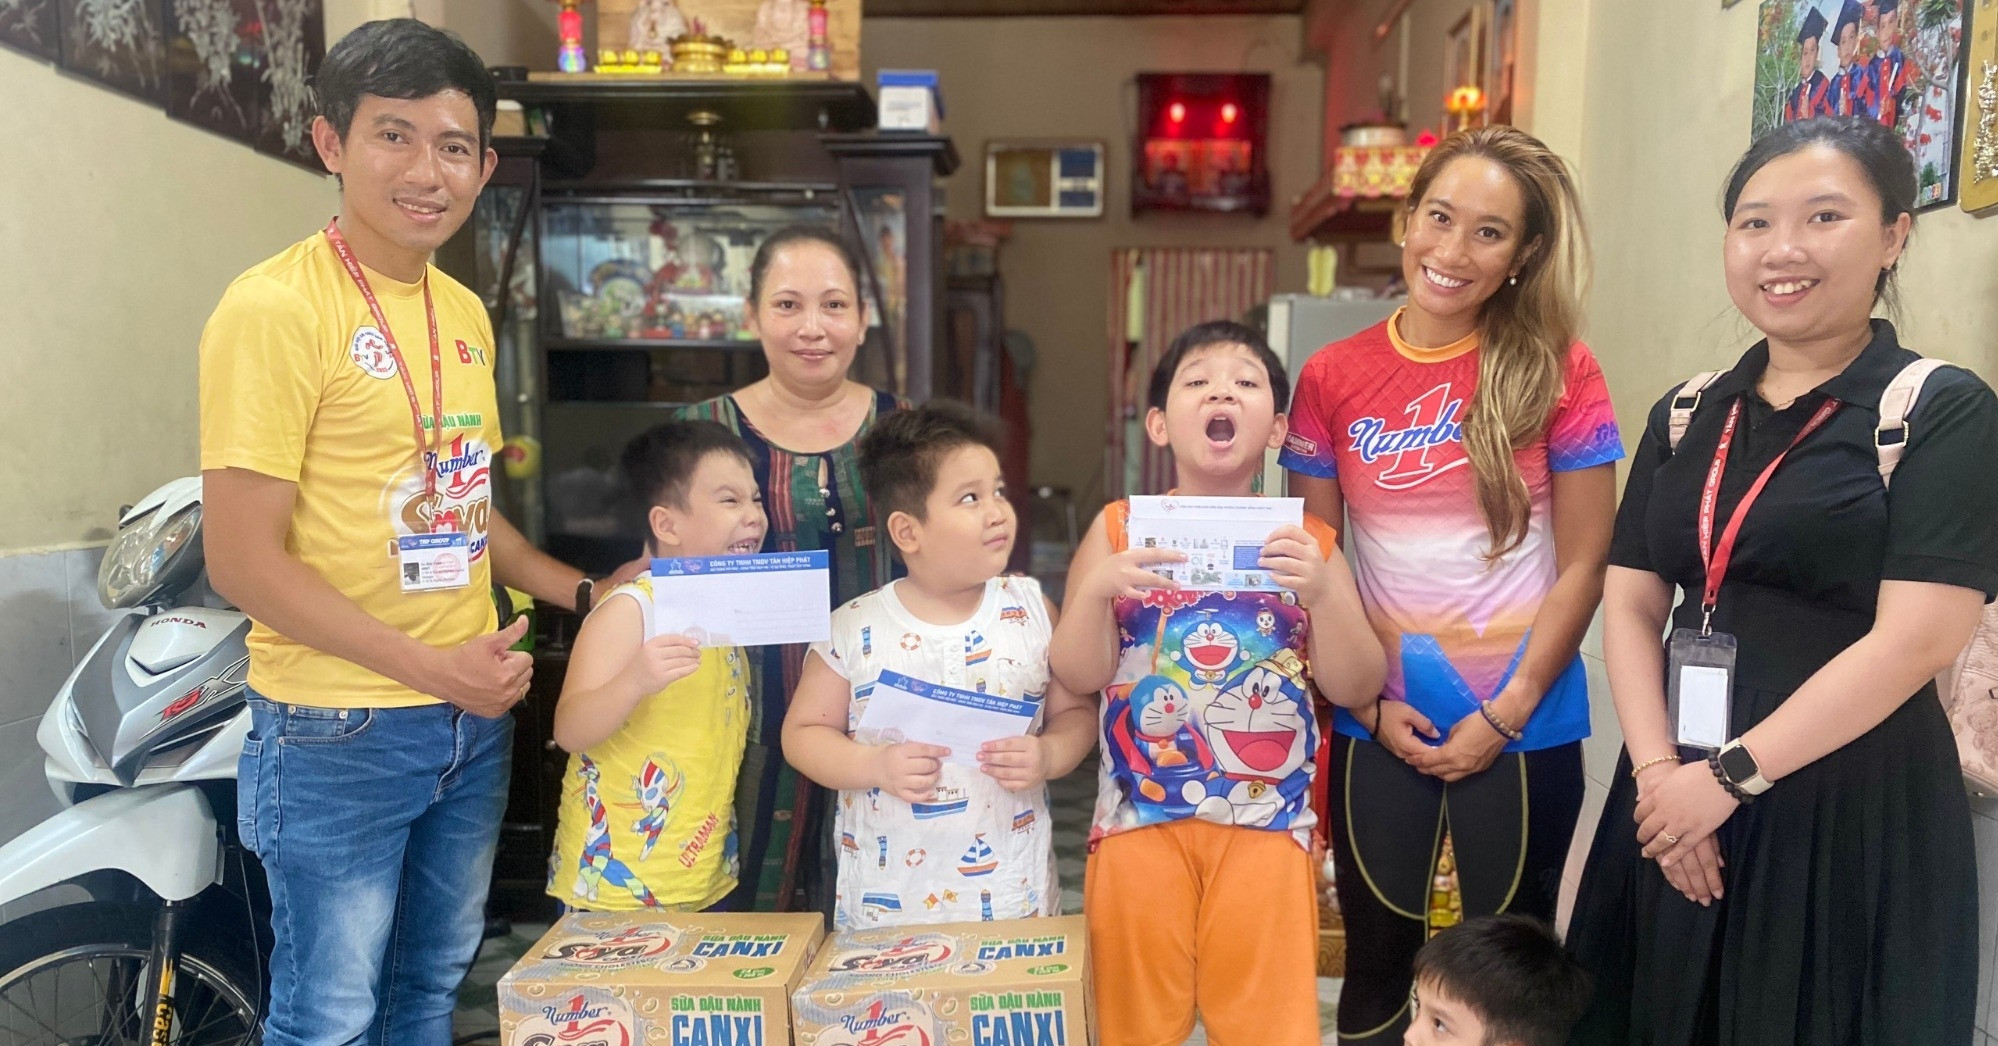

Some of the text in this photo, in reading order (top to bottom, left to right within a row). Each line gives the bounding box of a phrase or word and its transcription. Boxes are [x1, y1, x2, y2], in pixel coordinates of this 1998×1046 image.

[1348, 399, 1463, 464] Numbe
[150, 617, 207, 629] HONDA
[678, 811, 719, 868] ULTRAMAN
[692, 941, 784, 957] CANXI
[978, 941, 1064, 960] CANXI
[671, 995, 695, 1011] SỮA
[726, 995, 761, 1011] NÀNH
[970, 994, 995, 1011] SỮA
[1026, 990, 1062, 1008] NÀNH
[542, 1001, 608, 1025] Number
[841, 1007, 907, 1035] Number
[672, 1014, 763, 1046] CANXI
[972, 1010, 1065, 1046] CANXI
